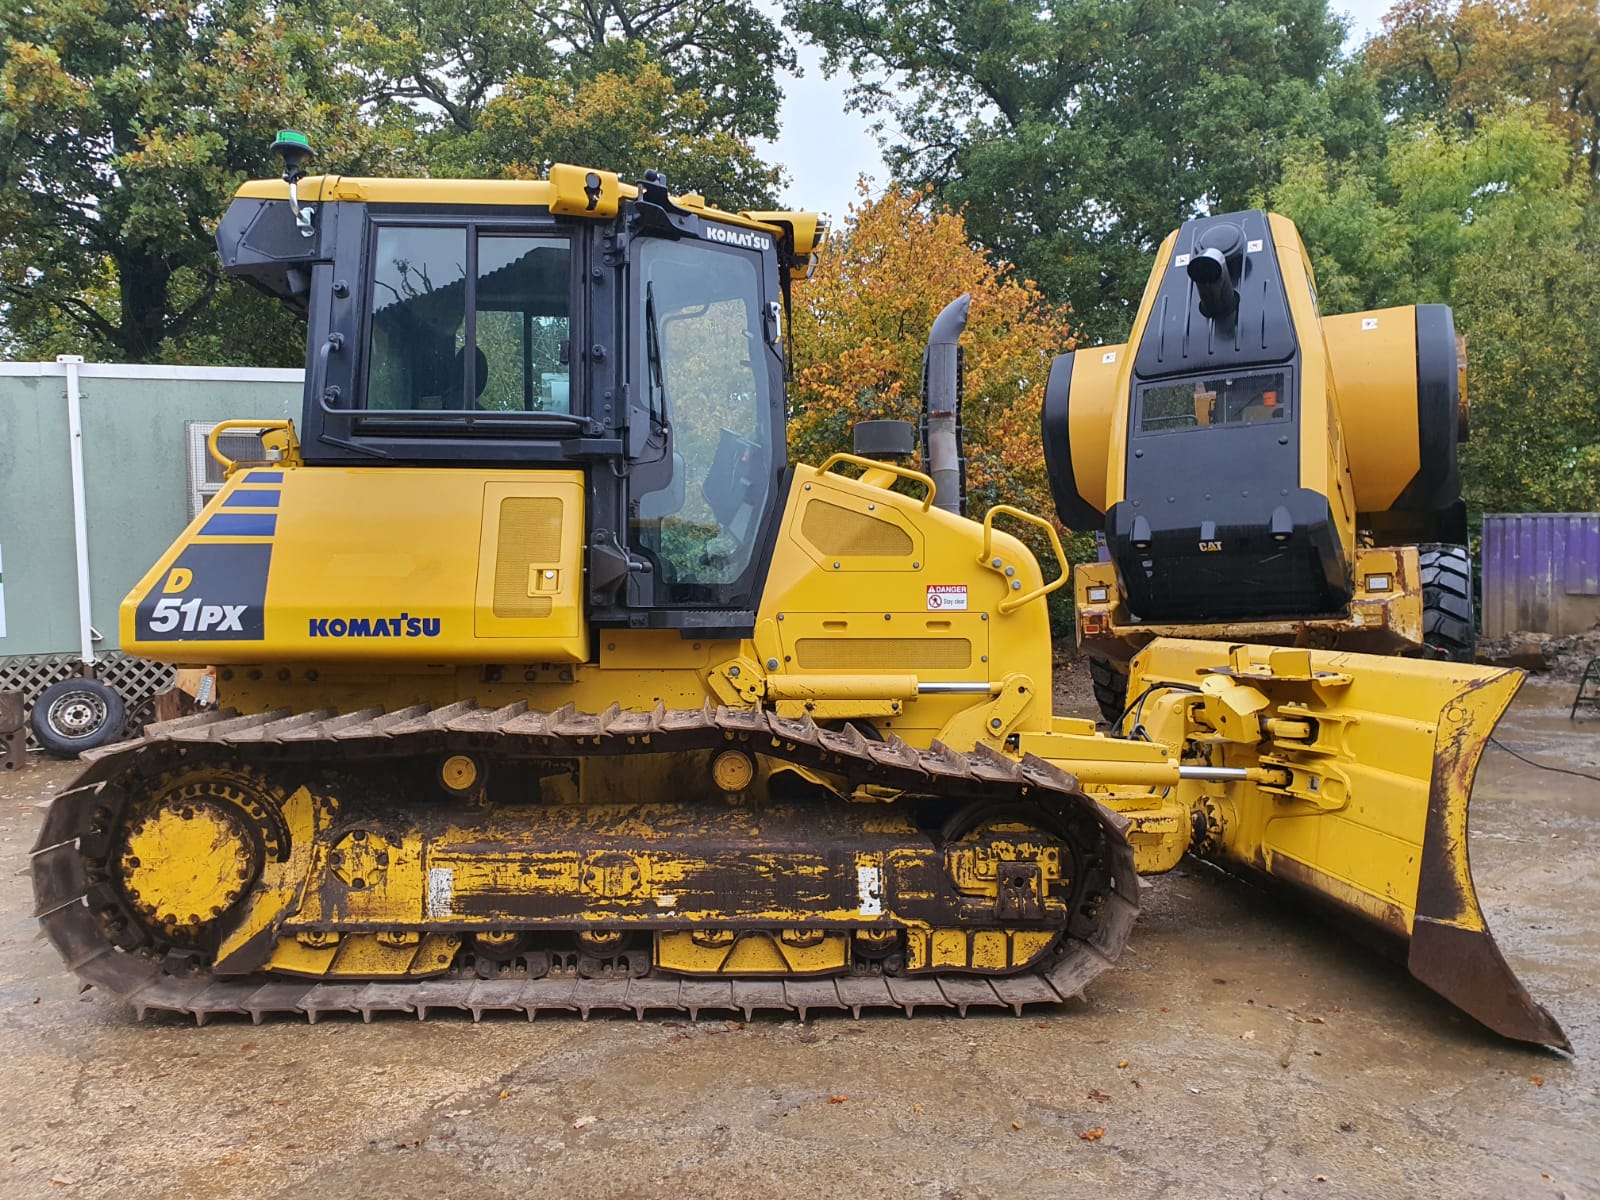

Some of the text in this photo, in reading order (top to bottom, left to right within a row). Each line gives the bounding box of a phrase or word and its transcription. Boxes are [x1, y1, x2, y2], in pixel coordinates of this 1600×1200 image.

[706, 227, 769, 250] KOMATSU
[1199, 541, 1222, 551] CAT
[162, 567, 193, 594] D
[943, 598, 953, 606] Stay
[149, 598, 248, 632] 51PX
[309, 612, 441, 637] KOMATSU
